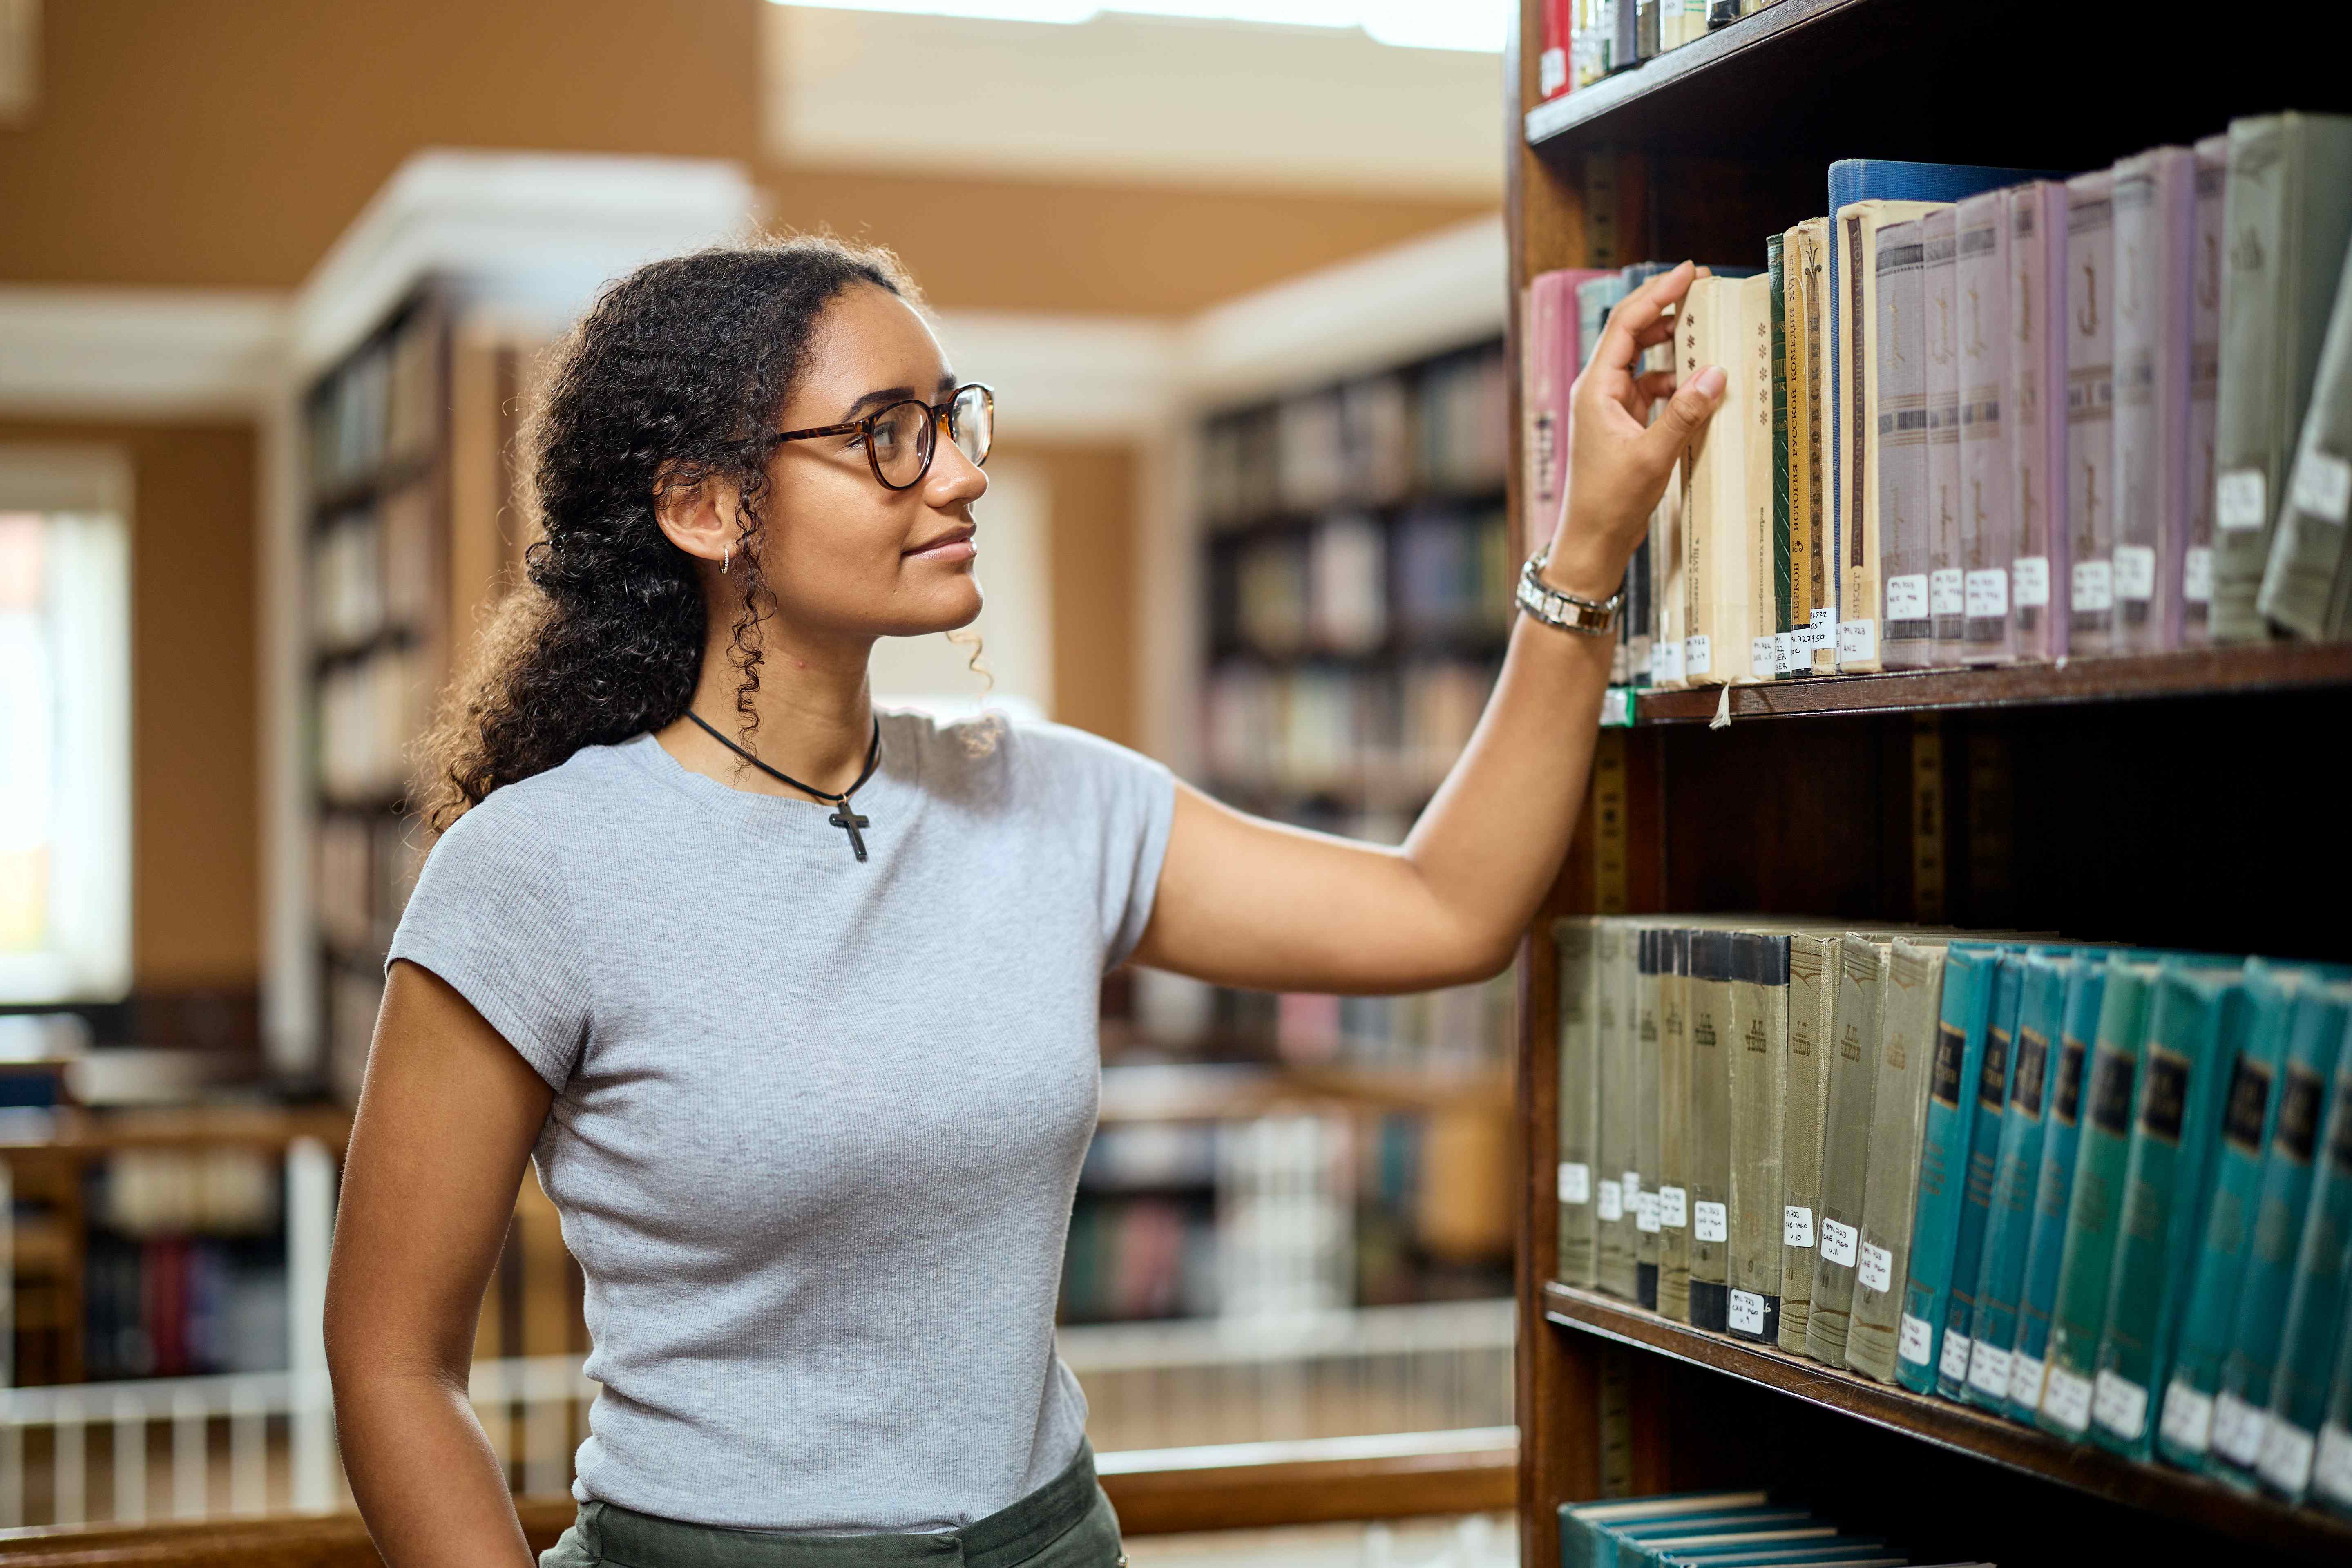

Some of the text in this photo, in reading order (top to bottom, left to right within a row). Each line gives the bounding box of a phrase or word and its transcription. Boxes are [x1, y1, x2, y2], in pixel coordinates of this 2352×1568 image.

[1851, 230, 1863, 292] ЧЕХОВА
[1855, 296, 1863, 318] ДО
[1856, 410, 1863, 431] ОТ
[1811, 621, 1824, 630] OST
[1825, 1222, 1847, 1239] 891.723
[1823, 1234, 1849, 1248] CHE 1960
